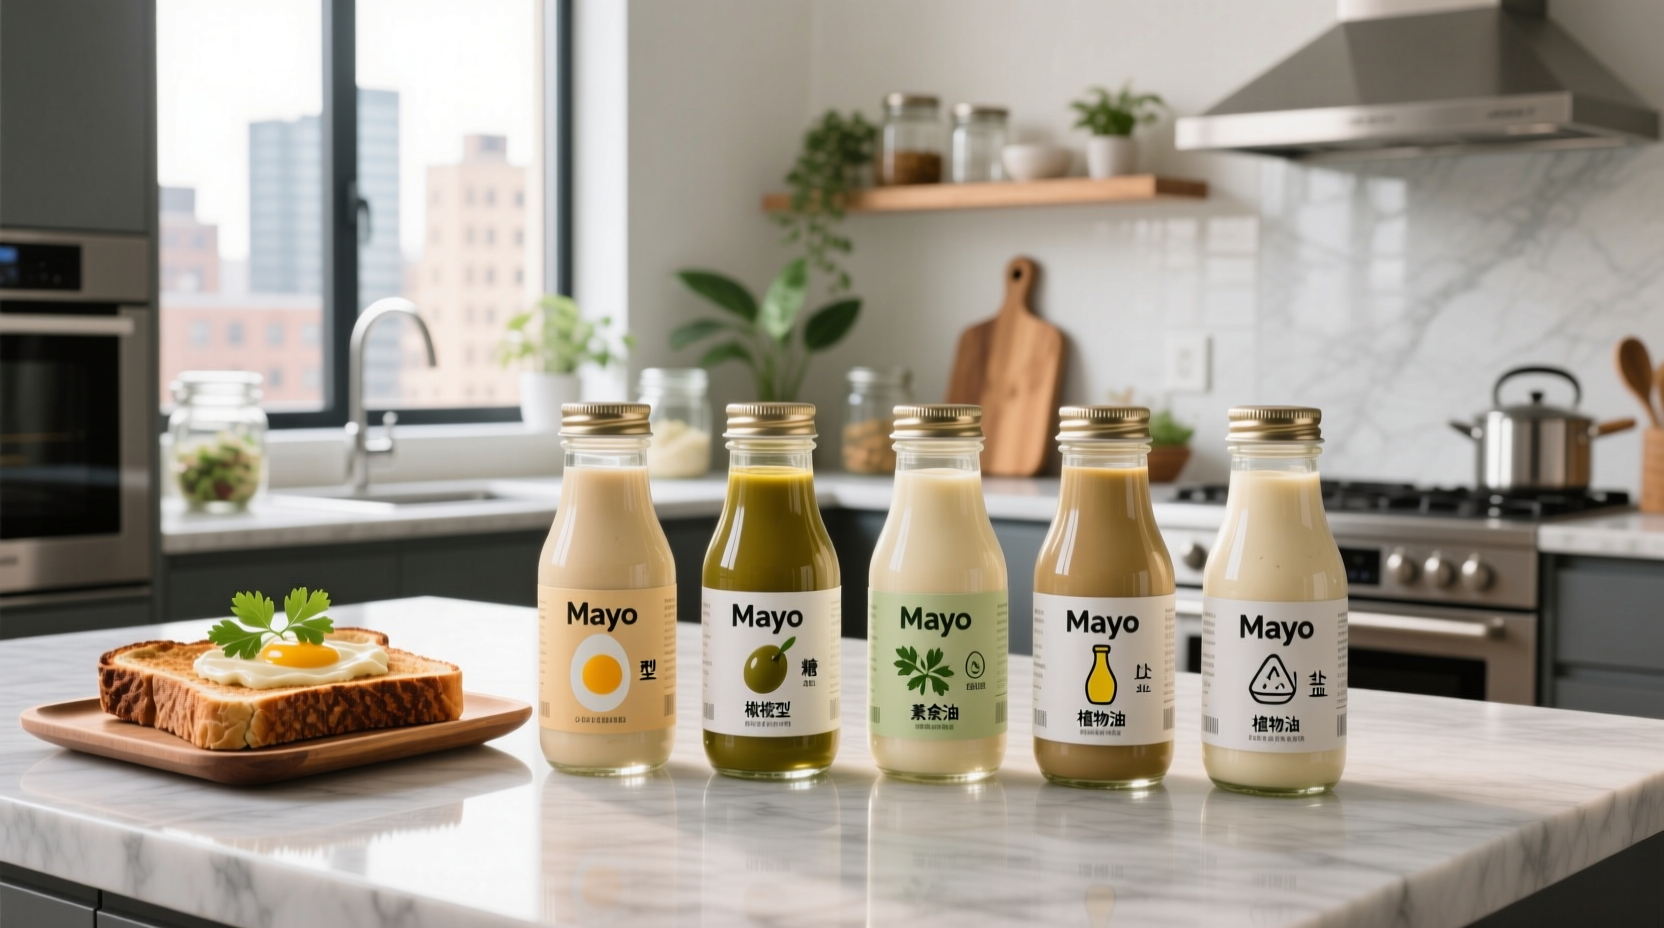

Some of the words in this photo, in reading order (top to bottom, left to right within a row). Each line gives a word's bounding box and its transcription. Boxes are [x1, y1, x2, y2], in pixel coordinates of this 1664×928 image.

[567, 601, 638, 632] Mayo
[732, 603, 803, 634] Mayo
[900, 606, 972, 637] Mayo
[1066, 609, 1140, 640] Mayo
[1240, 614, 1314, 646] Mayo
[1077, 708, 1126, 727] 植物油
[1251, 714, 1300, 733] 植物油
